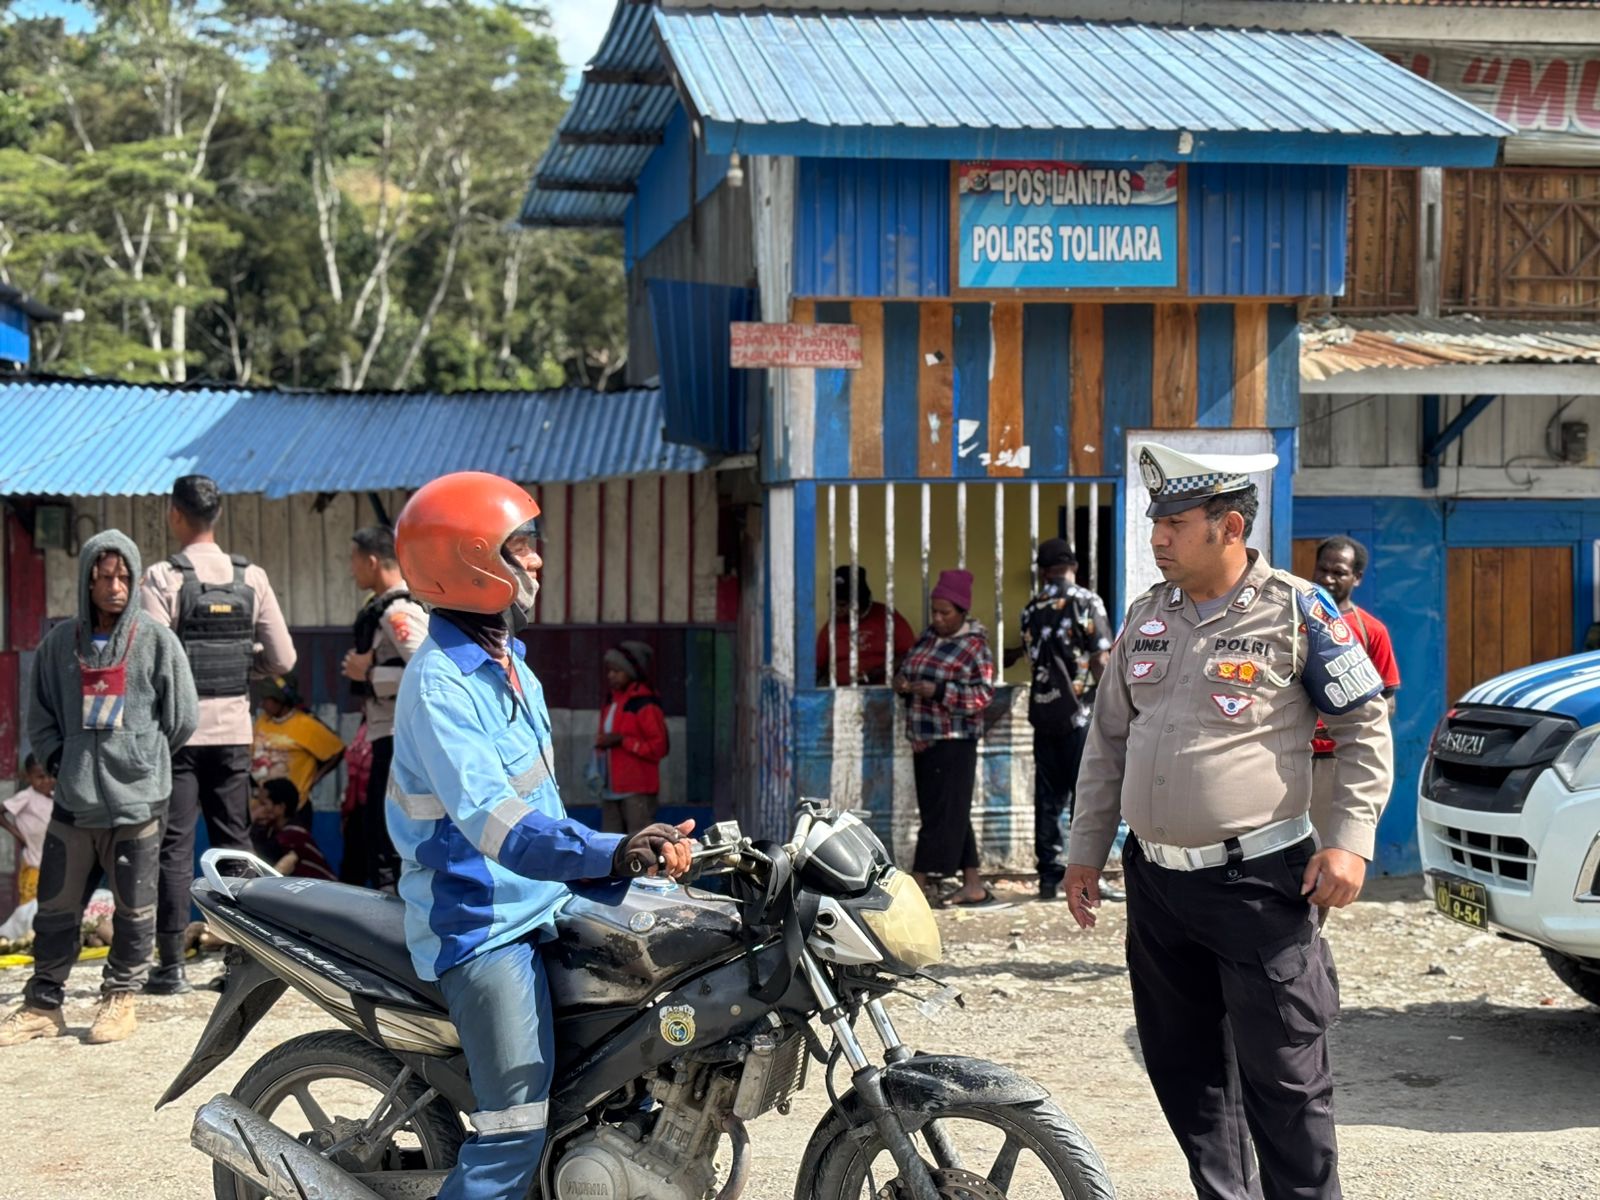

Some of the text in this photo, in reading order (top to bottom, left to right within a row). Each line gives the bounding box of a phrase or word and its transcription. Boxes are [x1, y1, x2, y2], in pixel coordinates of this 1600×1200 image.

[1002, 168, 1132, 206] POS LANTAS
[972, 225, 1163, 262] POLRES TOLIKARA
[1132, 639, 1170, 653] JUNEX
[1214, 638, 1270, 657] POLRI
[1446, 732, 1485, 755] ISUZU
